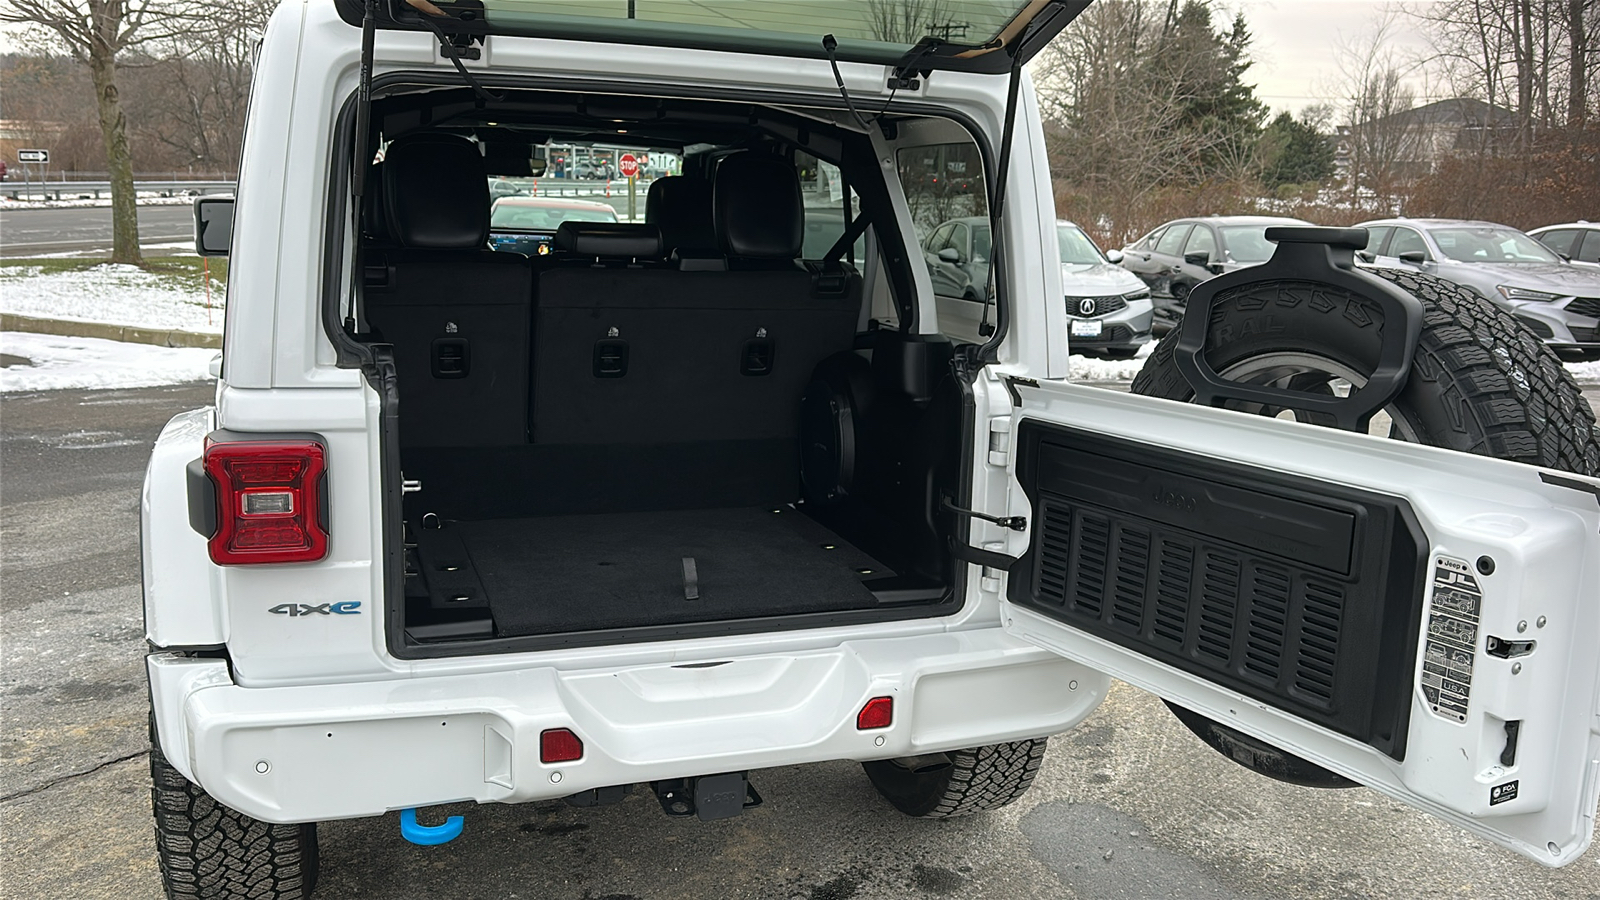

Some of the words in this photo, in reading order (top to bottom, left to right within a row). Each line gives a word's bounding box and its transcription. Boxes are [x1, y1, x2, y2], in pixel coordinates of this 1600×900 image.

[620, 160, 637, 171] STOP
[1207, 315, 1286, 349] RAL
[1152, 486, 1197, 513] Jeep
[1444, 560, 1461, 570] Jeep
[1502, 784, 1516, 793] FCA
